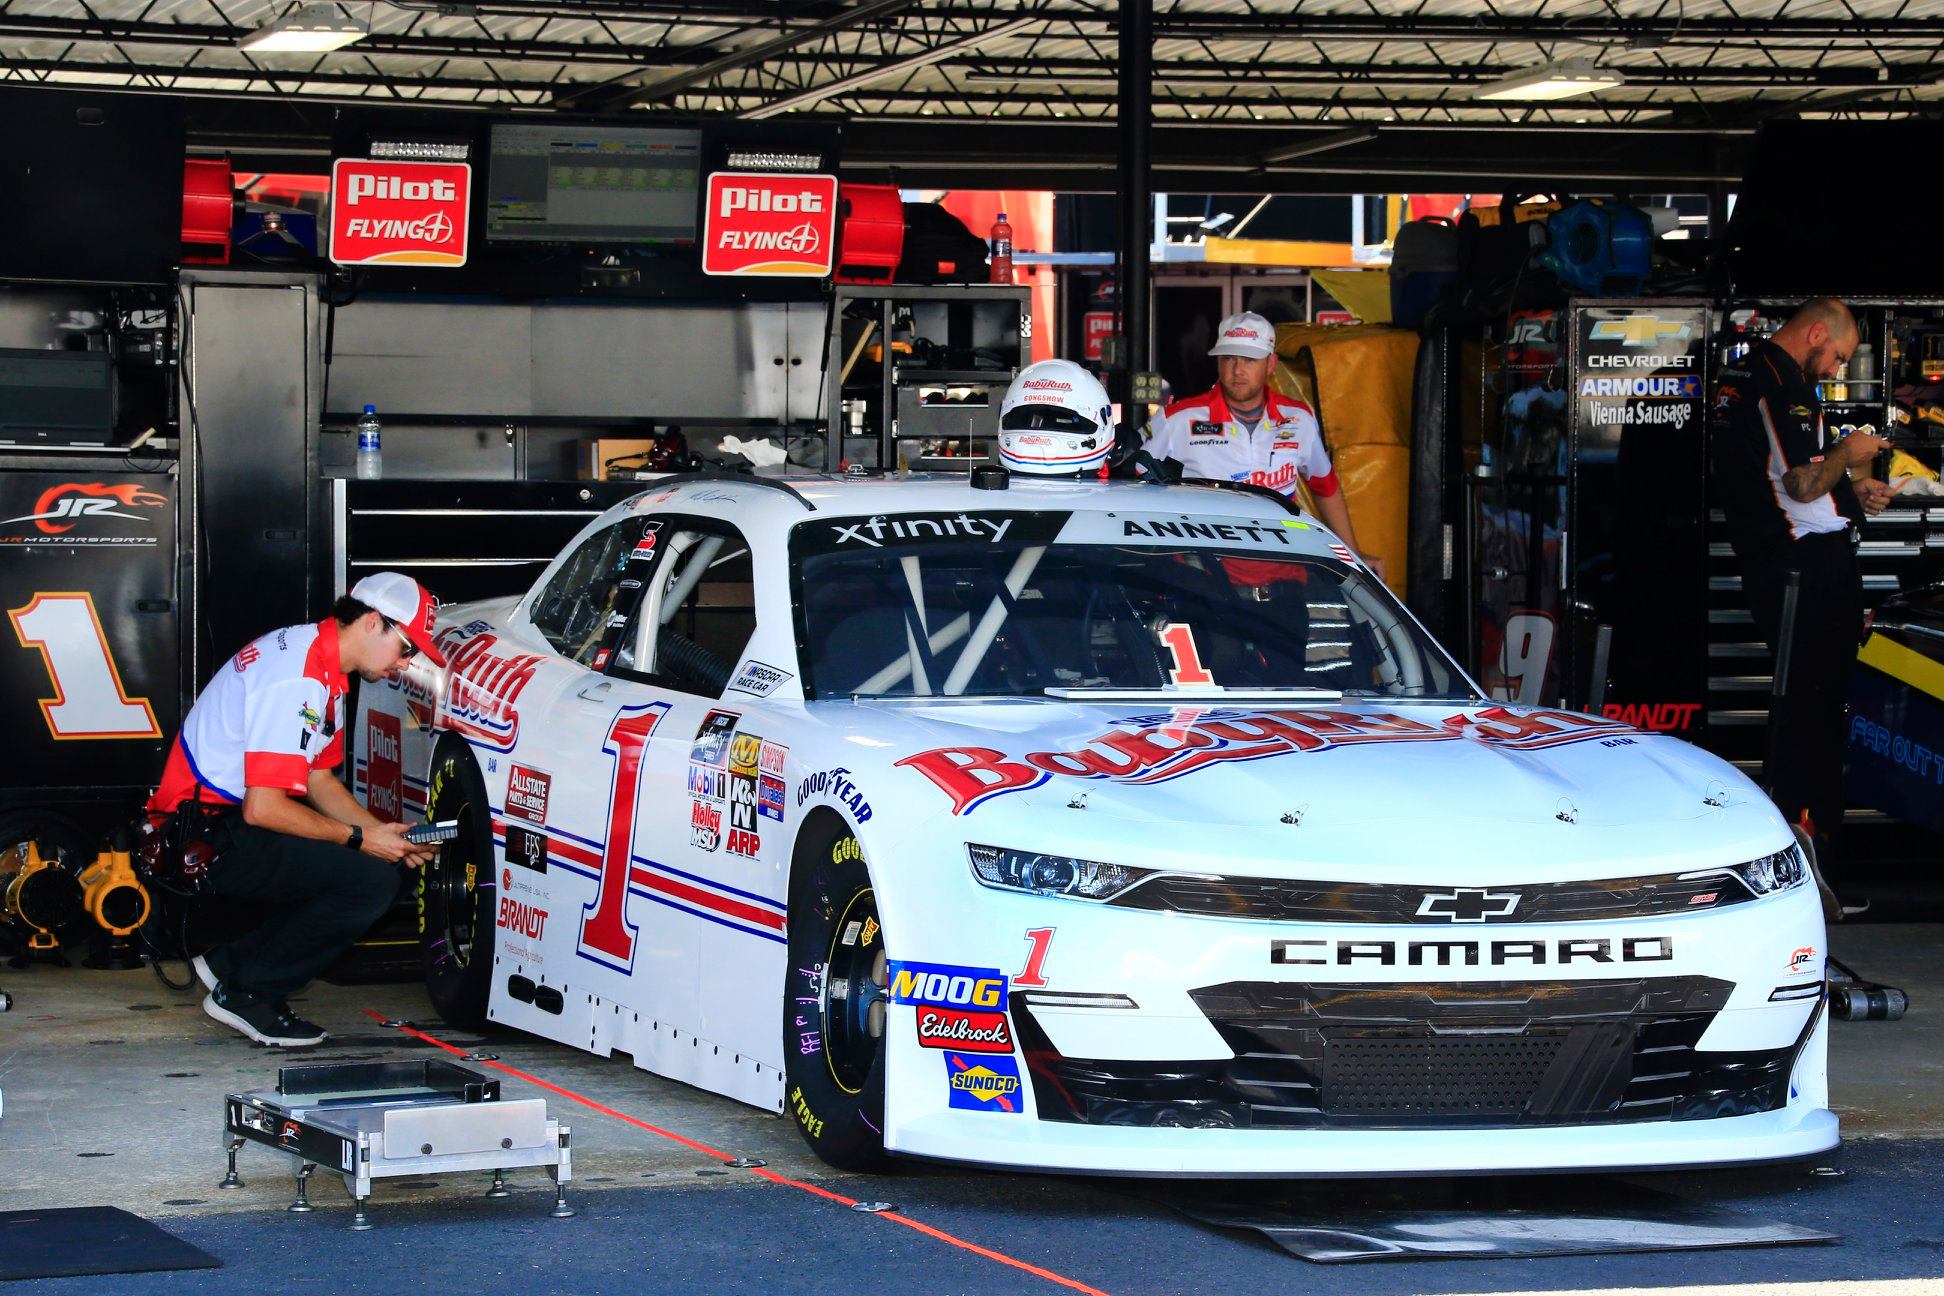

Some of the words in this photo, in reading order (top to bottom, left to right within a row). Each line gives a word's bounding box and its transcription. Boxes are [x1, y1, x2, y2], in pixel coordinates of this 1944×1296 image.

[347, 173, 456, 206] Pilot
[720, 187, 823, 218] Pilot
[1587, 354, 1696, 368] CHEVROLET
[1580, 377, 1682, 397] ARMOUR
[1589, 400, 1634, 428] Vienna
[1635, 400, 1692, 431] Sausage
[831, 514, 1013, 548] xfinity
[1123, 520, 1290, 545] ANNETT
[7, 591, 164, 740] 1
[1157, 622, 1216, 686] 1
[750, 665, 782, 684] NASCAR
[752, 681, 770, 692] CAR
[1583, 703, 1702, 731] RANDT
[370, 724, 398, 764] Pilot
[1851, 715, 1891, 757] FAR
[1892, 735, 1932, 777] OUT
[687, 766, 715, 796] Mobil
[797, 767, 874, 825] GOODYEAR
[508, 790, 523, 805] PARTS
[526, 795, 545, 812] SERVICE
[692, 800, 722, 837] Holley
[577, 701, 674, 977] 1
[689, 825, 722, 853] MSD
[726, 828, 761, 857] ARP
[496, 897, 549, 942] BRANDT
[1009, 926, 1057, 988] 1
[1270, 936, 1673, 966] CAMARO
[889, 970, 1004, 1007] MOOG
[919, 1012, 1009, 1044] Edelbrock
[953, 1073, 1017, 1093] SUNOCO
[791, 1085, 823, 1139] EAGLE
